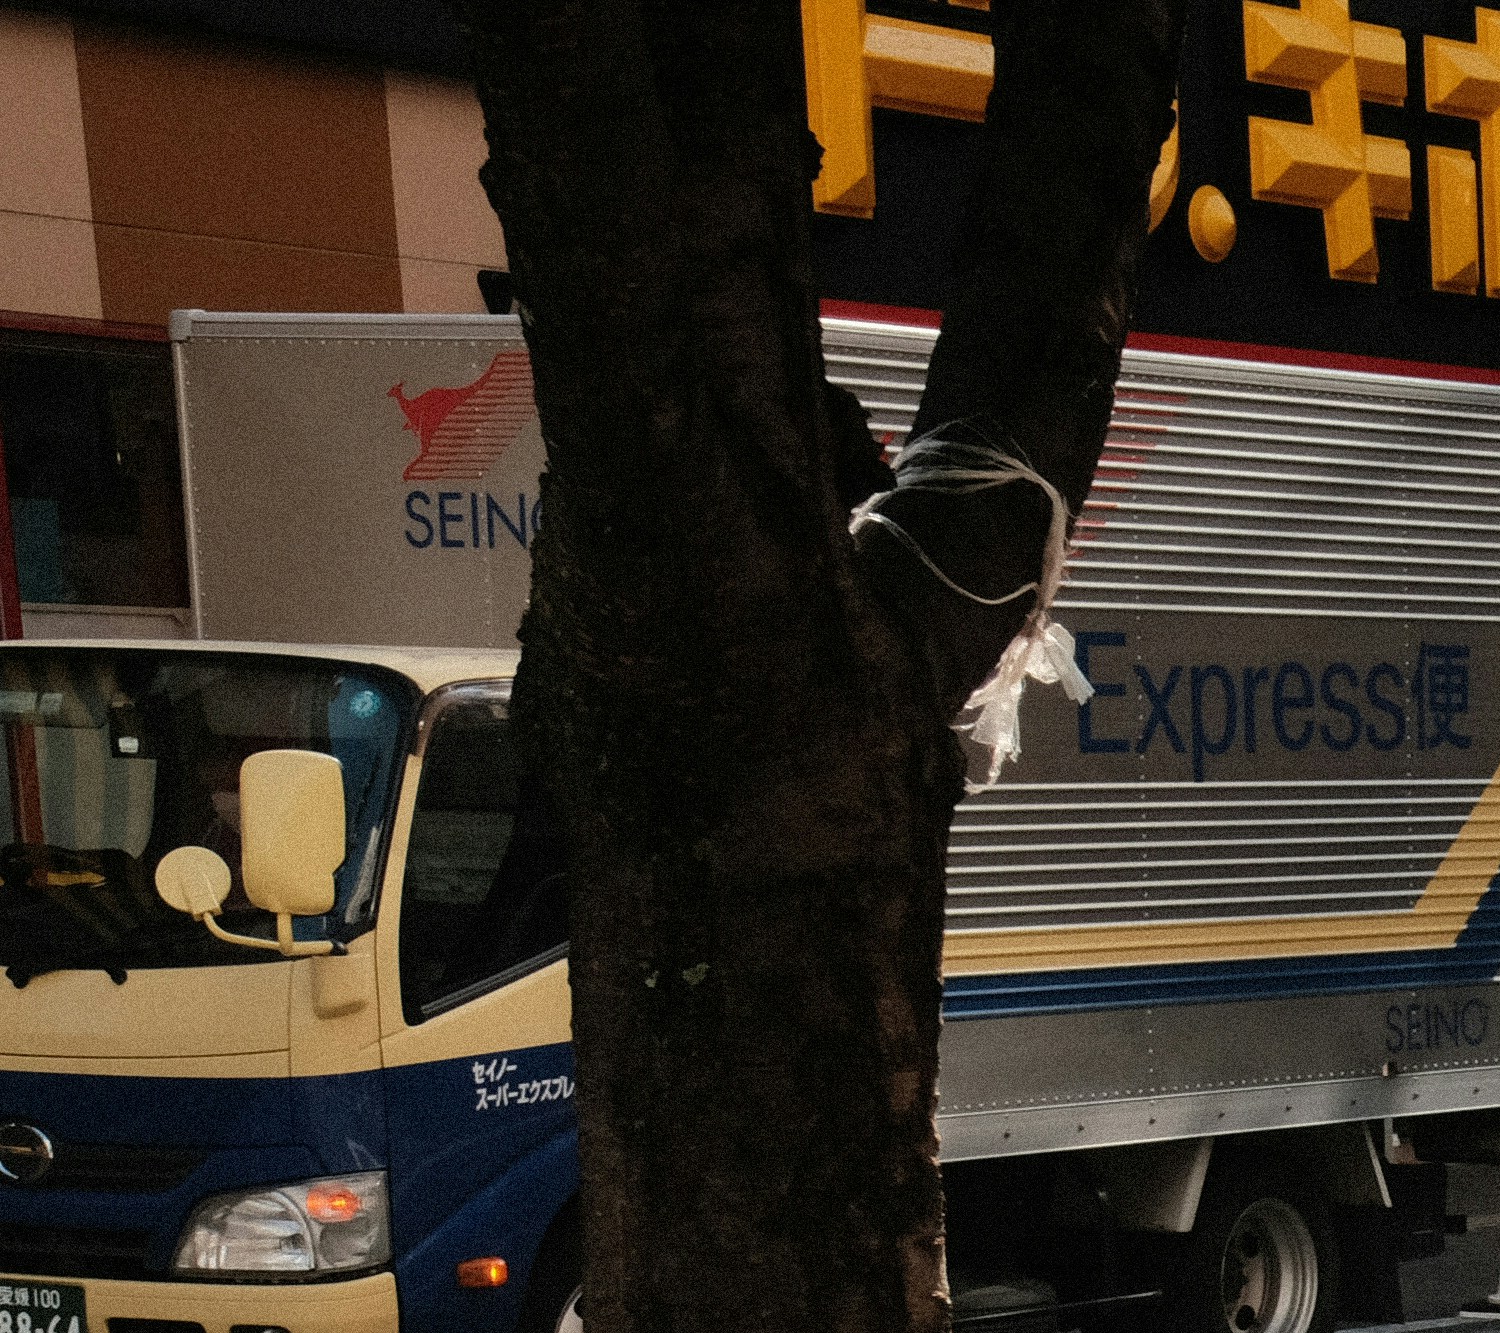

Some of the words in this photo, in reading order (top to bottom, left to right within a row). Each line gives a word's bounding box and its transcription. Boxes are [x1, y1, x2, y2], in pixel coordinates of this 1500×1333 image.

[1075, 629, 1472, 781] Express便
[1386, 998, 1489, 1054] SEINO
[471, 1057, 518, 1084] セイノー
[33, 1288, 61, 1310] 100
